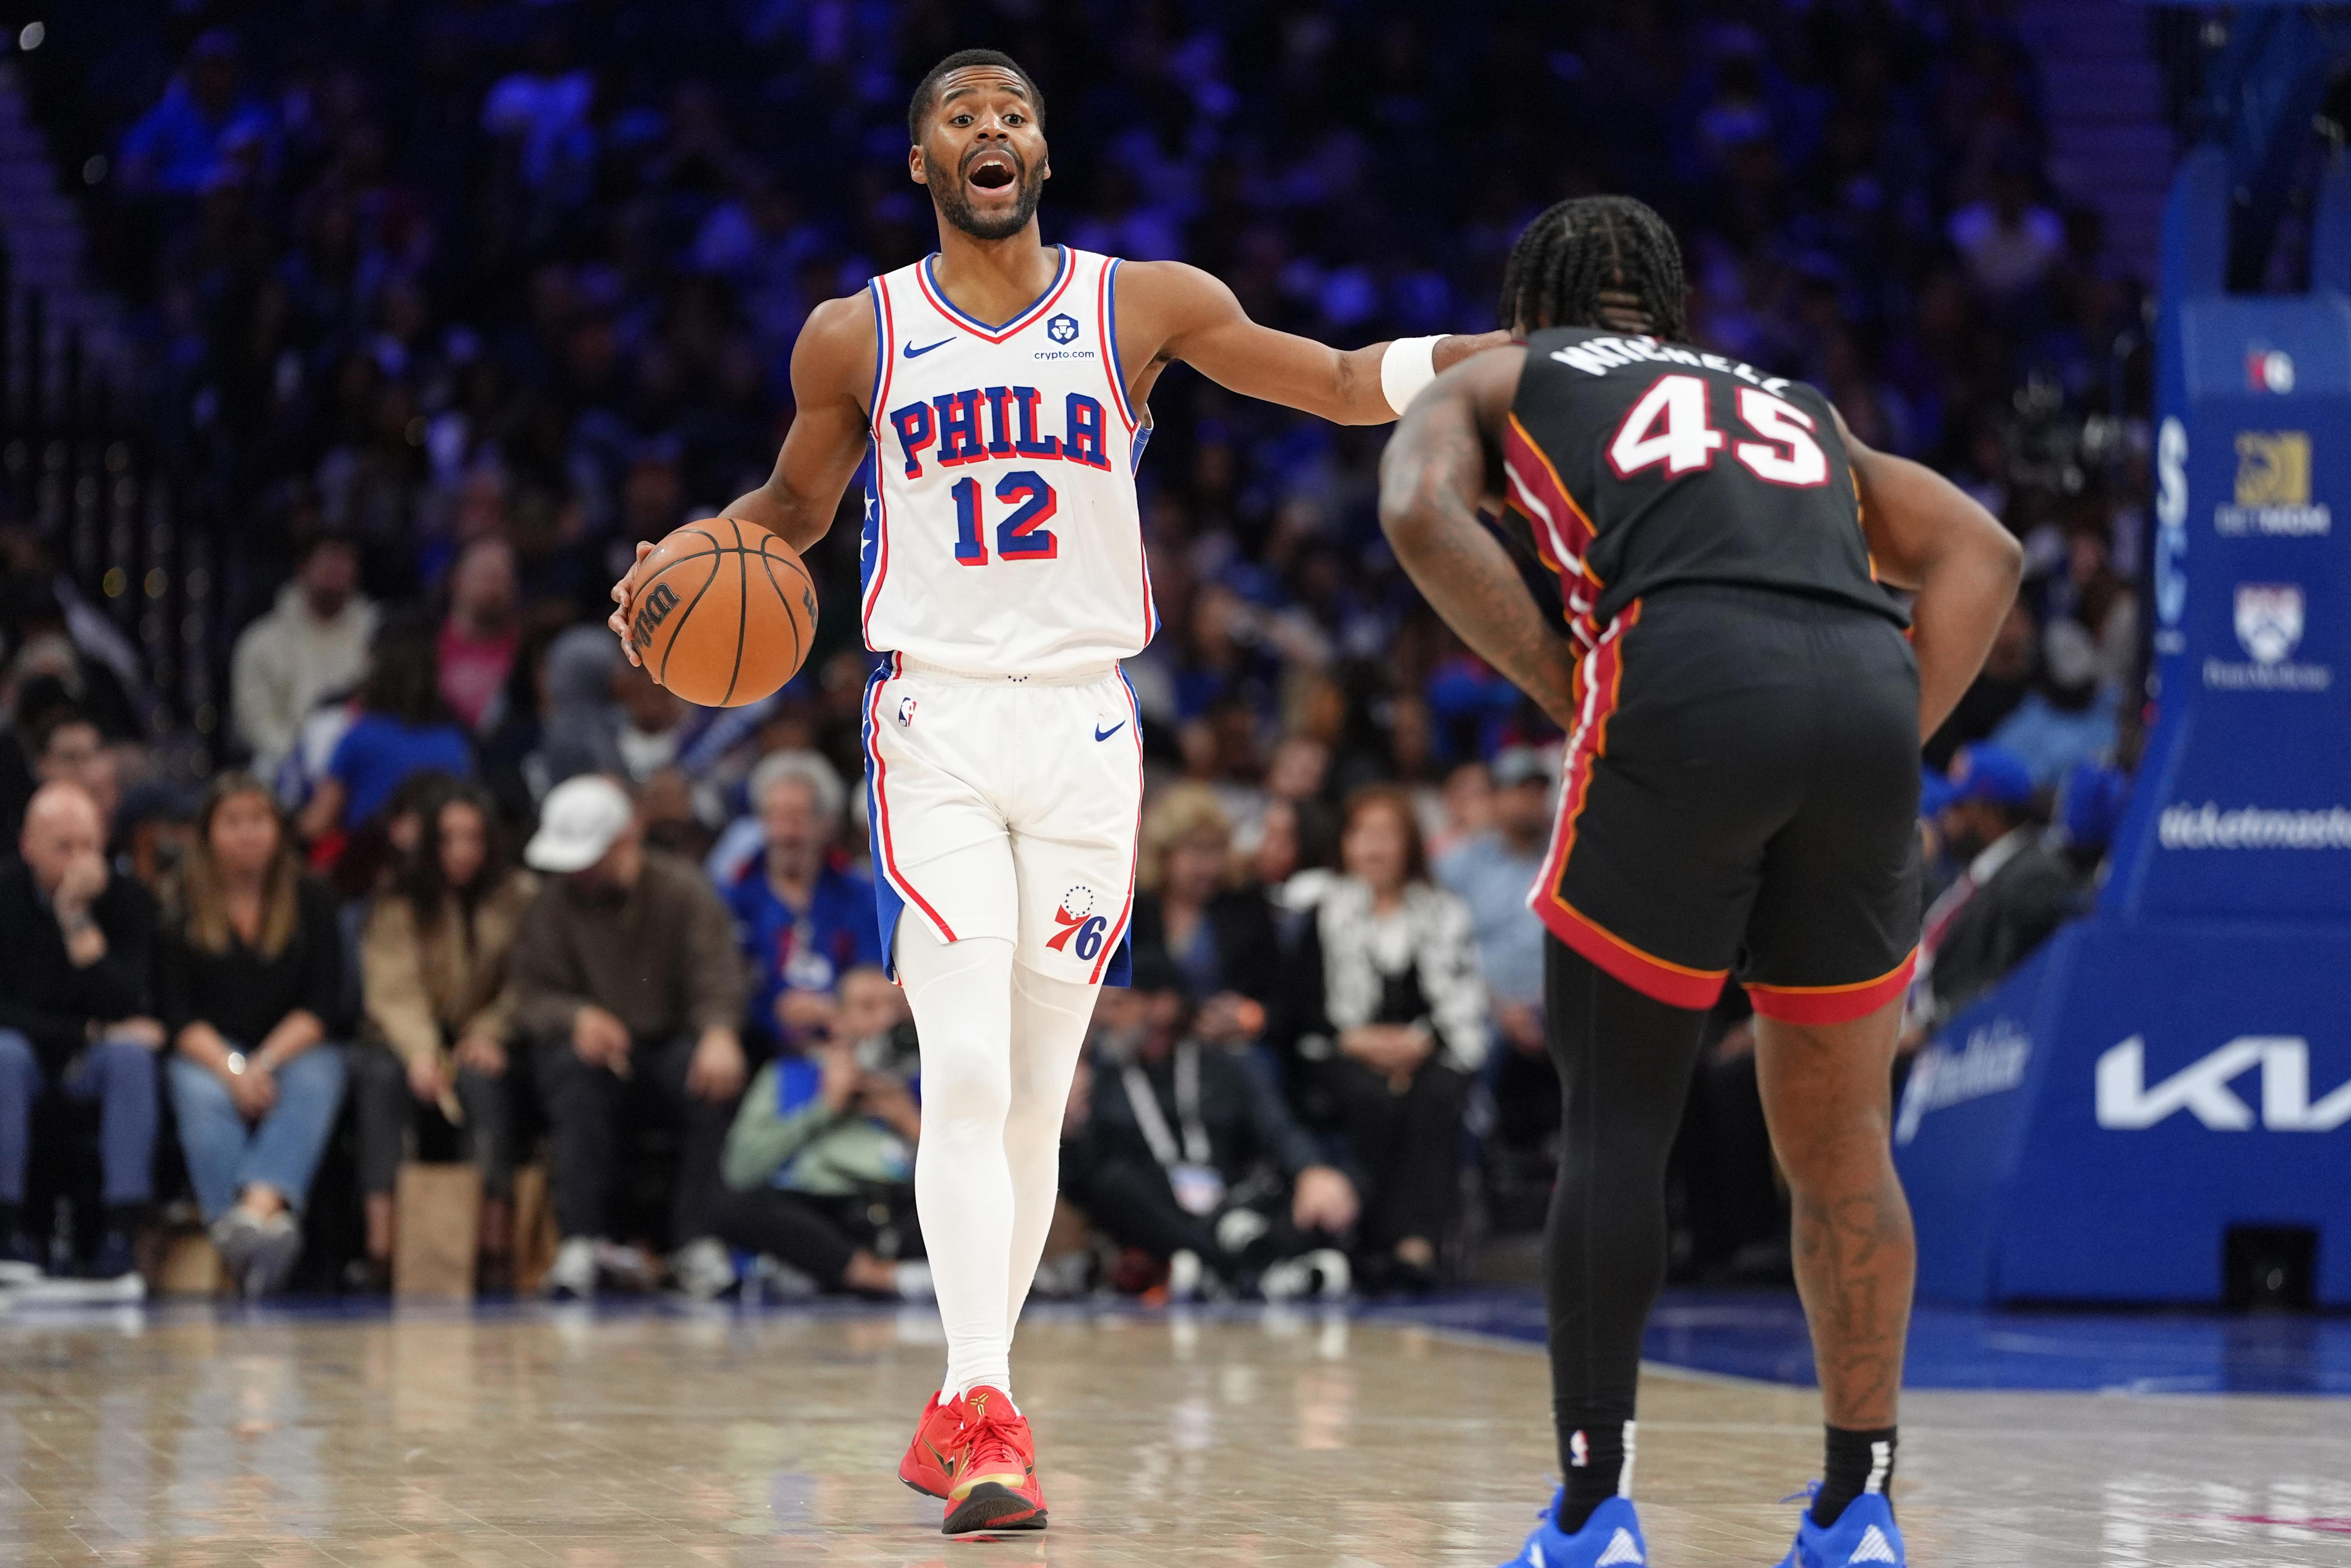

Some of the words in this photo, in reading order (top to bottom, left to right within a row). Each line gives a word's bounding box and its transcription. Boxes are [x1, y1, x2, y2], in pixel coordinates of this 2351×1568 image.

[1034, 350, 1094, 360] crypto.com
[890, 386, 1111, 480] PHILA
[1604, 373, 1831, 488] 45
[951, 471, 1057, 566] 12
[1045, 904, 1107, 961] 76
